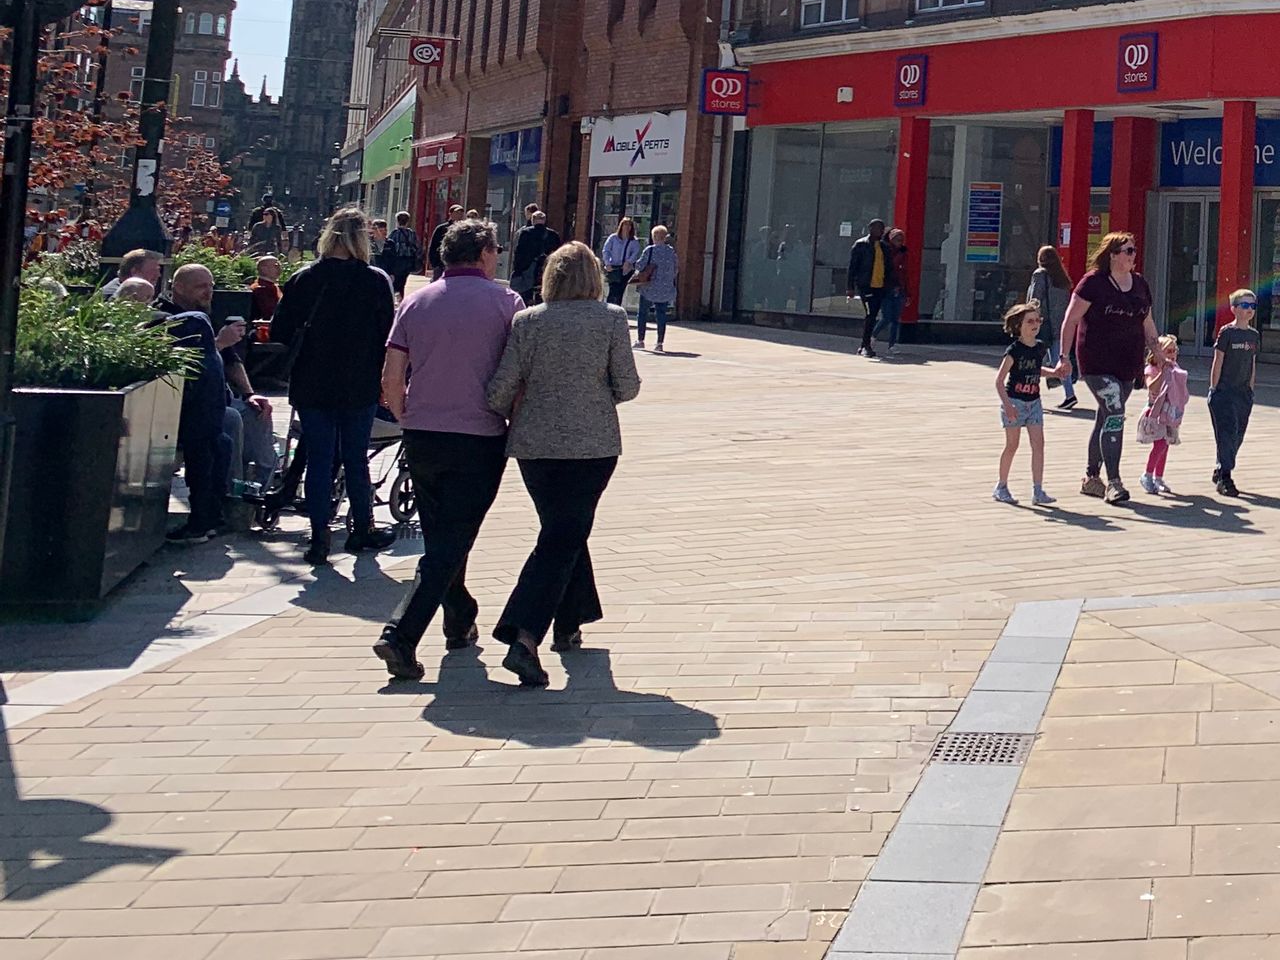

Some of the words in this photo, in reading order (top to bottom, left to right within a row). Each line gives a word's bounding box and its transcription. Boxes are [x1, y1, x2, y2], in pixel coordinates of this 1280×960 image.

[1124, 44, 1149, 70] QD
[900, 64, 920, 87] QD
[1124, 71, 1148, 83] stores
[711, 77, 741, 98] QD
[898, 89, 919, 100] stores
[711, 98, 741, 109] stores
